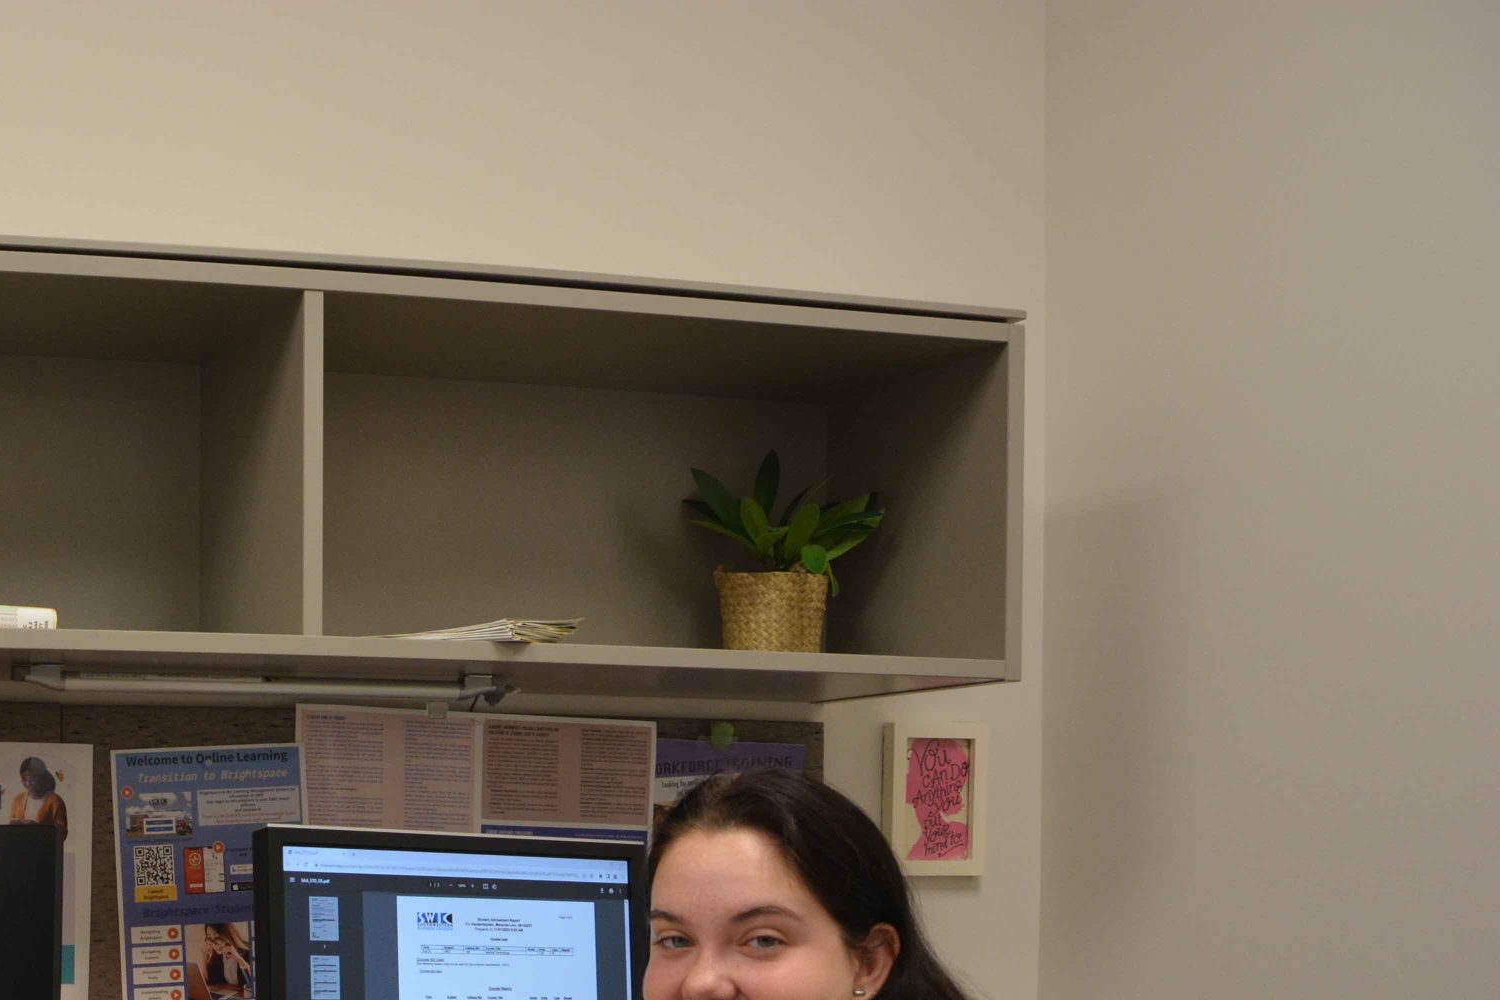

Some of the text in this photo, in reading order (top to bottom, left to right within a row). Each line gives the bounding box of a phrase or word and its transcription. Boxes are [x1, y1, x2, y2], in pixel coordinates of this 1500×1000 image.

[126, 750, 289, 768] Welcome to Online Learning
[136, 768, 288, 784] Transition to Brightspace
[417, 912, 454, 924] SWIC
